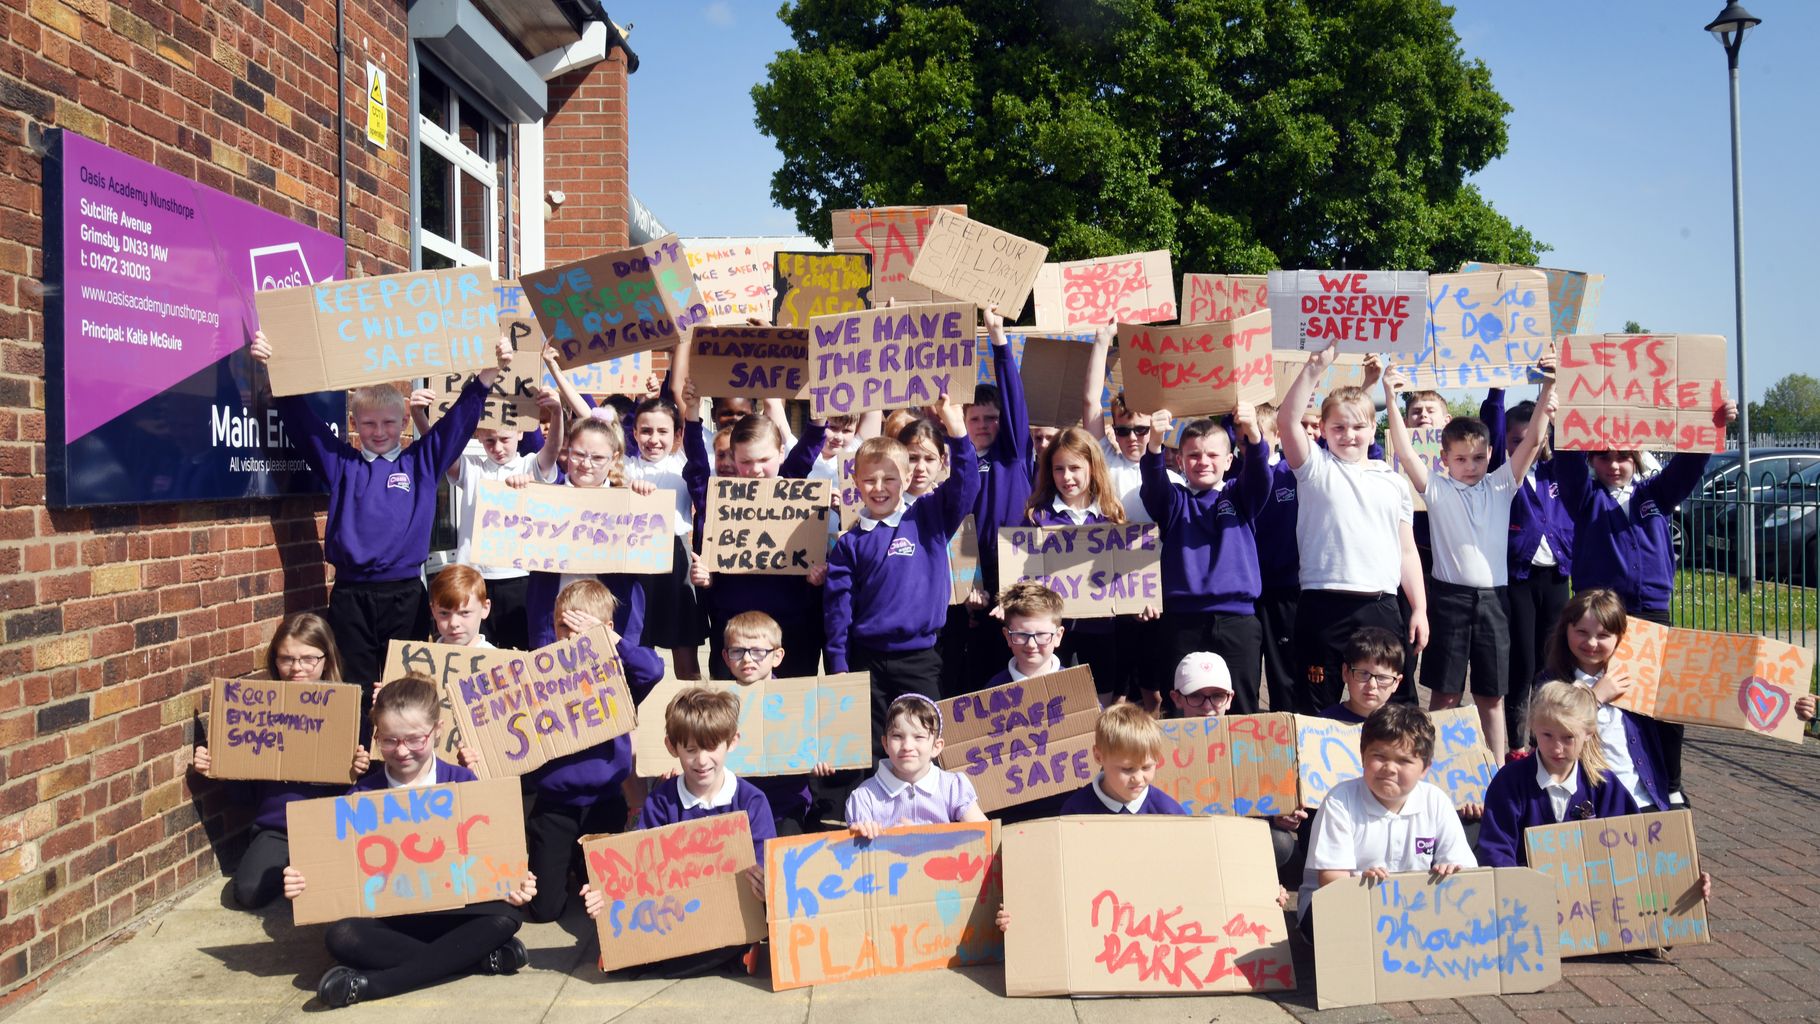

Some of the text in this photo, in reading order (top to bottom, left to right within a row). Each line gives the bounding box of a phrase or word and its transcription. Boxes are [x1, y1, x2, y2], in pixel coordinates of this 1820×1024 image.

[80, 166, 194, 219] Oasis Academy Nunsthorpe
[80, 198, 152, 234] Sutcliffe Avenue
[80, 224, 168, 262] Grimsby, DN33 1AW
[938, 212, 988, 244] KEEP
[991, 235, 1028, 261] OUR
[81, 249, 150, 281] t: 01472 310013
[728, 263, 759, 276] SAFER
[928, 232, 1024, 286] CHILDREN
[315, 273, 484, 314] KEEP OUR
[534, 267, 593, 295] WE
[1318, 273, 1368, 294] WE
[81, 285, 219, 328] www.oasisacademynunsthorpe.org
[337, 302, 498, 343] CHILDREN
[1301, 295, 1410, 318] DESERVE
[82, 319, 182, 350] Principal: Katie McGuire
[777, 328, 809, 341] OU
[815, 311, 962, 348] WE HAVE
[1306, 316, 1404, 342] SAFETY
[816, 349, 872, 381] THE
[879, 339, 976, 373] RIGHT
[1561, 336, 1668, 378] LETS
[729, 362, 801, 390] SAFE
[810, 373, 951, 413] TO PLAY
[1568, 373, 1701, 410] MAKE
[212, 404, 260, 448] Main
[230, 456, 240, 472] All
[240, 457, 264, 473] visitors
[265, 458, 287, 475] please
[718, 480, 759, 501] THE
[773, 480, 823, 501] REC
[719, 529, 776, 548] BE A
[1011, 523, 1157, 556] PLAY SAFE
[1089, 571, 1157, 600] SAFE
[1615, 637, 1796, 687] SAFER PARK
[1694, 633, 1769, 658] HAVE
[1779, 645, 1806, 669] A
[459, 659, 524, 705] KEEP
[534, 636, 600, 674] OUR
[1638, 665, 1733, 698] SAFER
[224, 680, 335, 706] Keep our
[953, 685, 1024, 722] PLAY
[987, 695, 1066, 738] SAFE
[965, 730, 1048, 776] STAY
[1006, 749, 1091, 795] SAFE
[357, 814, 490, 878] our
[1599, 820, 1662, 848] OUR
[1095, 933, 1204, 990] PARK
